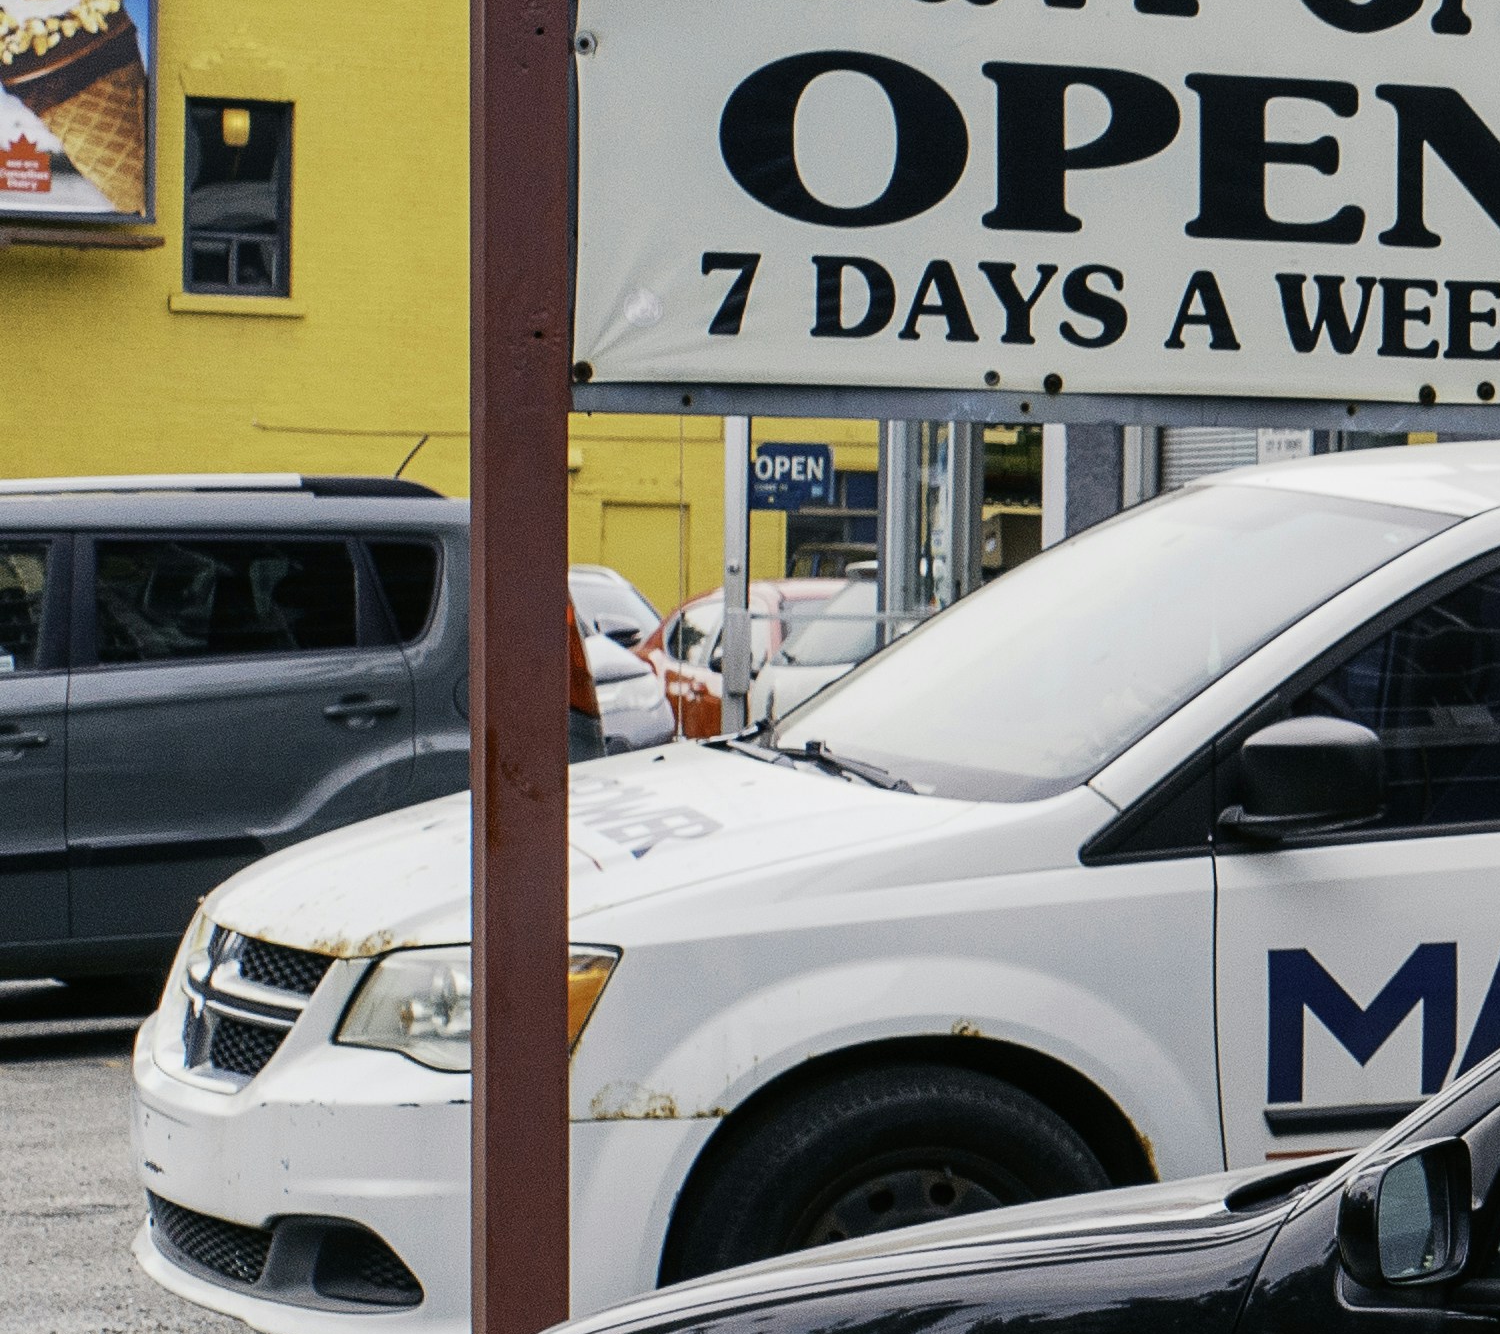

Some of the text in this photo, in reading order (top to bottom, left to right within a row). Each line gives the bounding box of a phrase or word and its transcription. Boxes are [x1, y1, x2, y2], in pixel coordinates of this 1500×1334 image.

[701, 251, 762, 336] 7
[810, 255, 1128, 349] DAYS
[1164, 270, 1241, 351] A
[755, 455, 824, 482] OPEN
